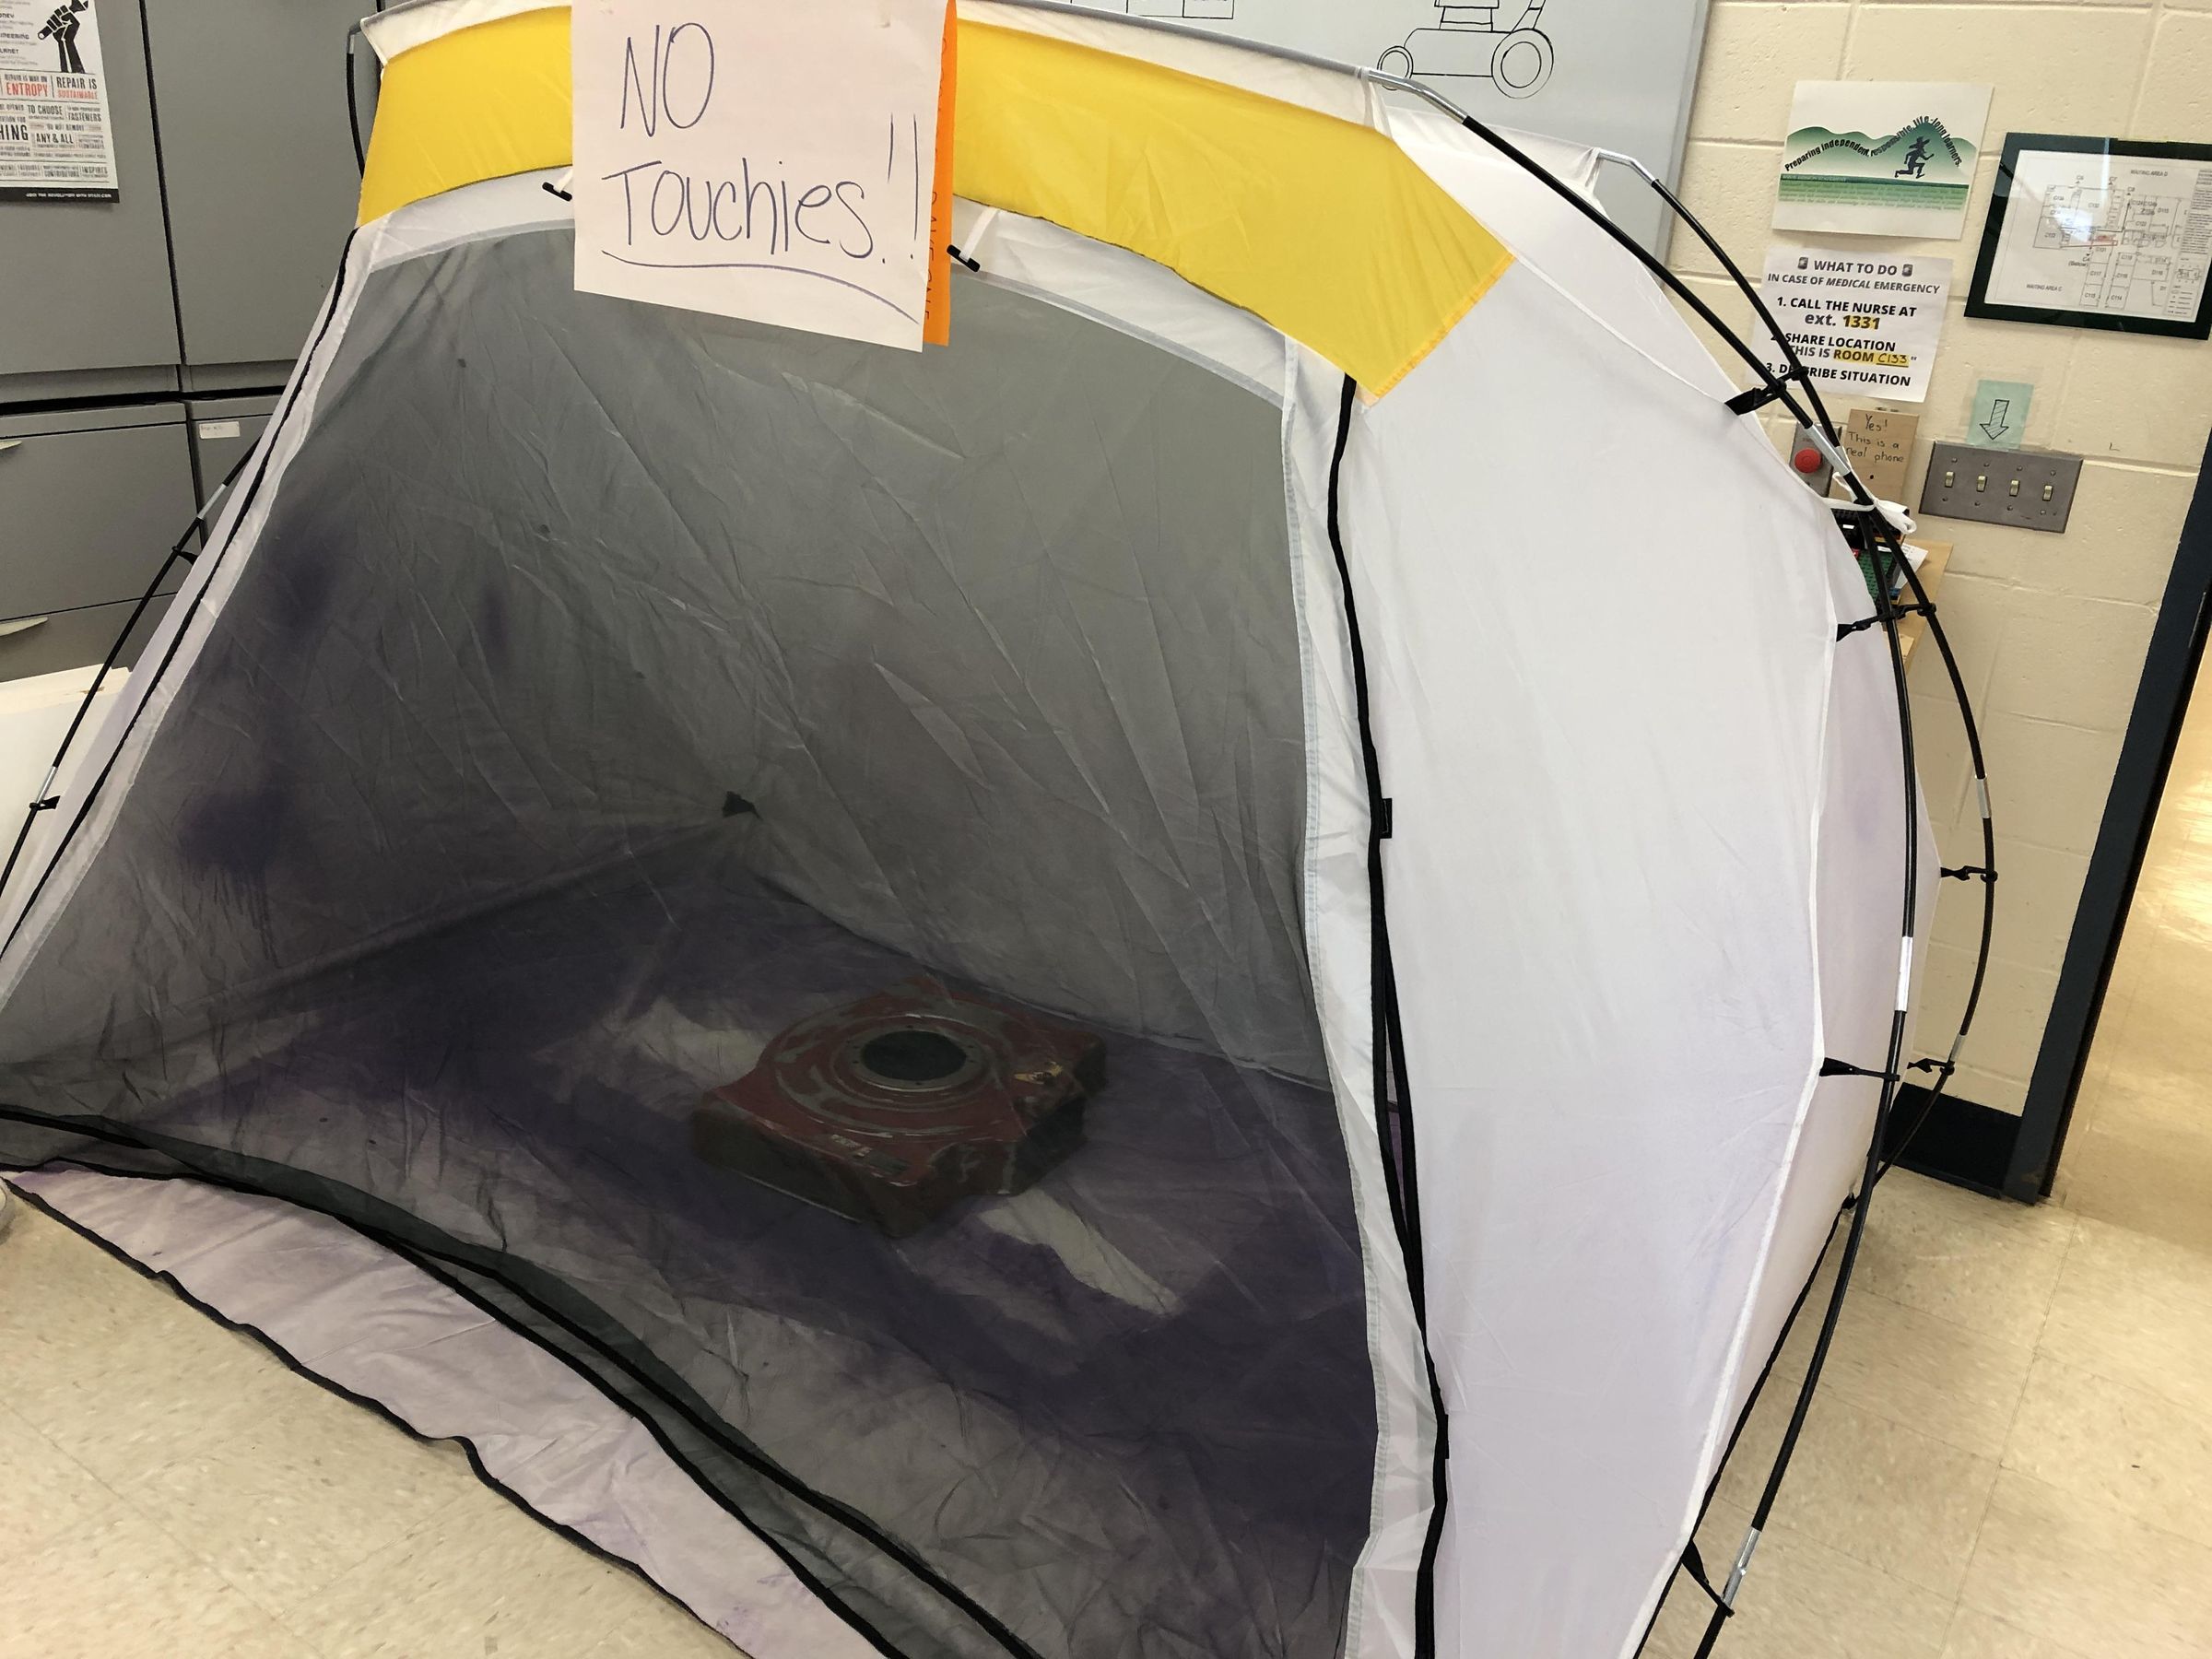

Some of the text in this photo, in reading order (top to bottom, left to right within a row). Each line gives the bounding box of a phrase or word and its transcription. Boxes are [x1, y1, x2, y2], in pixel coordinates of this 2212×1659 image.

[56, 76, 98, 89] REPAIR IS
[620, 22, 714, 137] NO
[6, 82, 48, 97] ENTROPY
[28, 104, 36, 114] TO
[38, 105, 63, 115] CHOOSE
[67, 112, 102, 122] FASTENERS
[36, 133, 51, 143] ANY
[52, 134, 59, 143] &
[60, 134, 74, 144] ALL
[1784, 146, 1821, 171] Preparing
[1821, 138, 1870, 158] independent,
[1814, 260, 1898, 276] WHAT TO DO
[1768, 273, 1940, 295] IN CASE OF MEDICAL EMERGENCY
[1777, 296, 1917, 317] 1. CALL THE NURSE AT
[1805, 312, 1881, 330] ext. 1331
[1785, 333, 1825, 346] SHARE
[1828, 336, 1896, 351] LOCATION
[1818, 348, 1830, 358] IS
[1833, 349, 1874, 362] ROOM
[1840, 371, 1911, 386] SITUATION
[1865, 413, 1888, 432] Yes!
[1848, 431, 1871, 445] This
[1877, 437, 1886, 447] is
[1845, 446, 1905, 464] real phone
